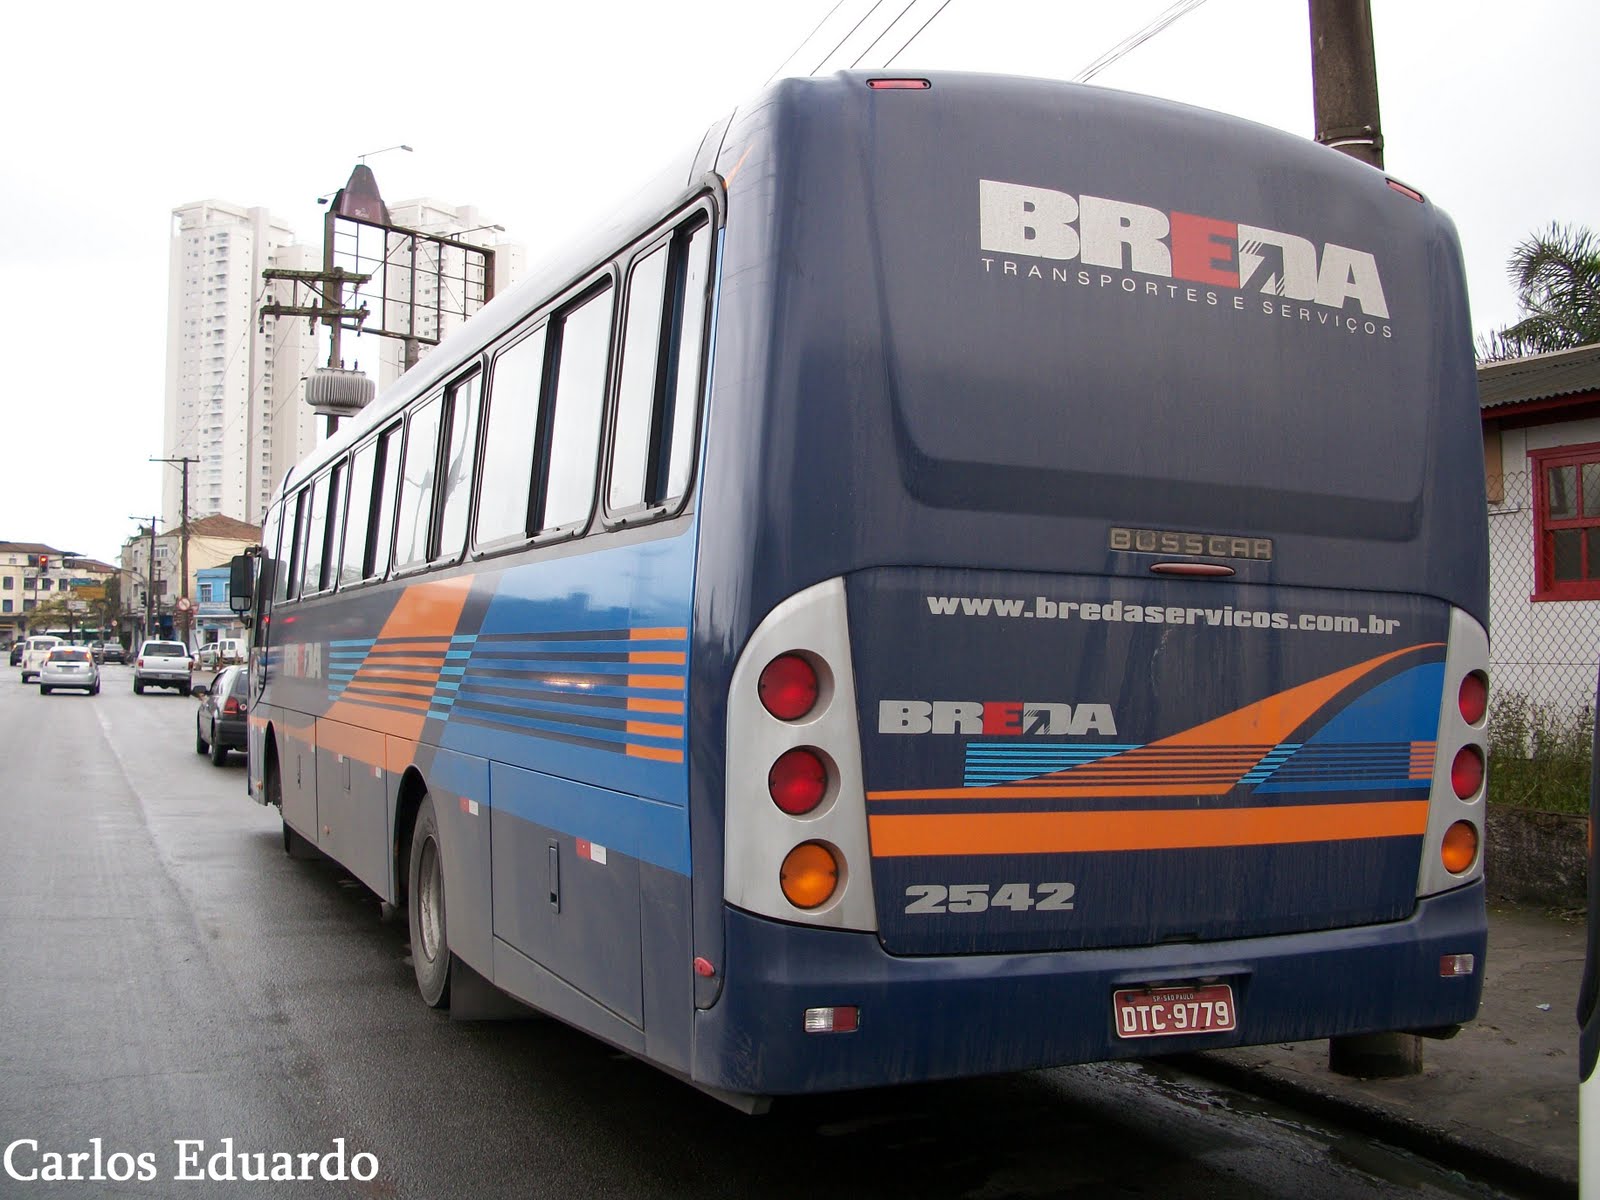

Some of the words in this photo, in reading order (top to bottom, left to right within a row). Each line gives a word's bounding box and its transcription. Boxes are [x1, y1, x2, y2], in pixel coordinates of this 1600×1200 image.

[979, 179, 1390, 319] BREDA
[982, 258, 1218, 306] TRANSPORTES
[1234, 296, 1245, 310] E
[1263, 301, 1392, 338] SERVIÇOS
[1111, 527, 1273, 560] BUSSCAR
[927, 596, 1400, 635] www.bredaservicos.com.br
[878, 700, 1117, 736] BREDA
[905, 882, 1075, 914] 2542
